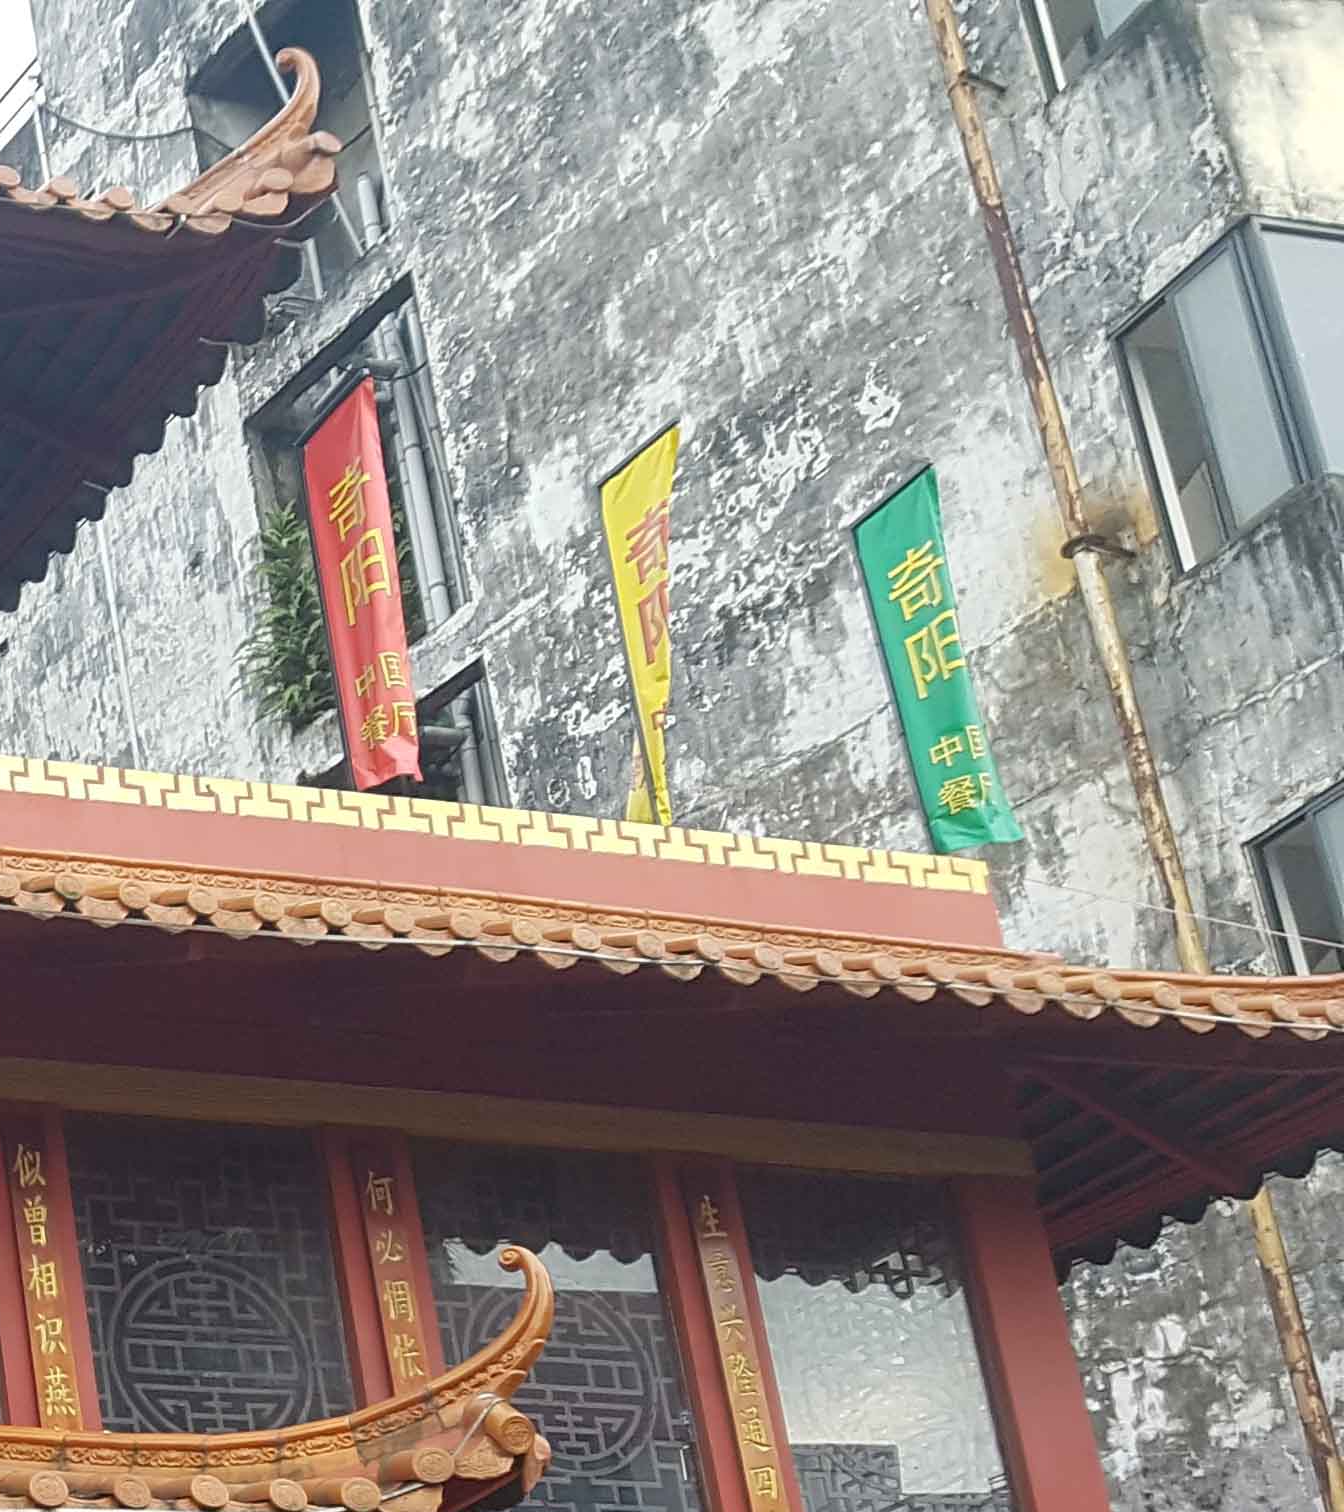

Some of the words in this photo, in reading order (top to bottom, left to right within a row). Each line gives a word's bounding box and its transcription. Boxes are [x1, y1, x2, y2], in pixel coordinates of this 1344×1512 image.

[328, 456, 393, 627] 奇阳
[11, 1142, 80, 1431] 似曾相识燕
